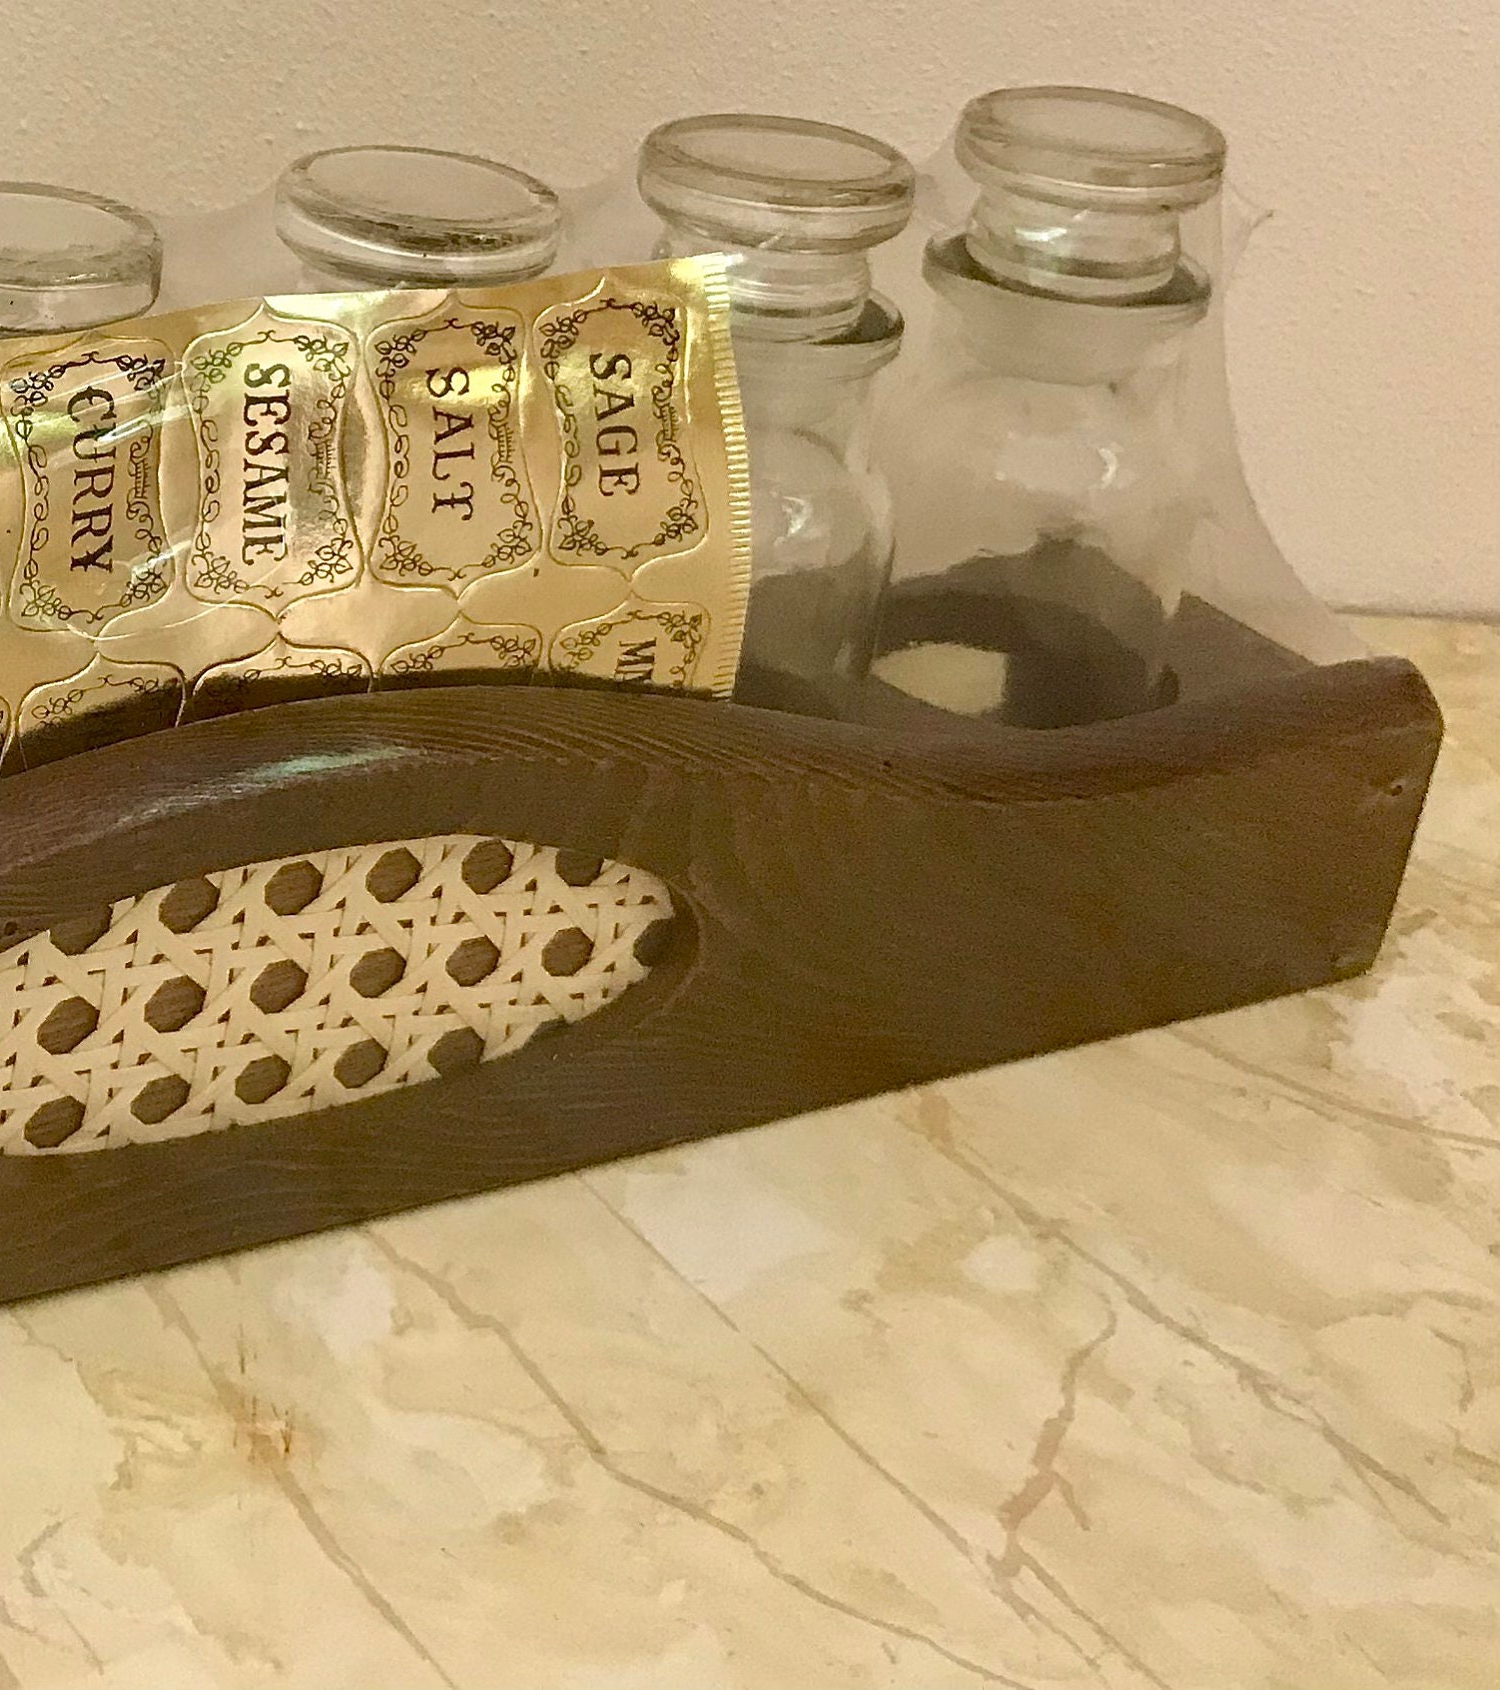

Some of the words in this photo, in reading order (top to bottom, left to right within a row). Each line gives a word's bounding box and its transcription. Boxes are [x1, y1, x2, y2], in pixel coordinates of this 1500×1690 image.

[67, 386, 117, 573] CURRY
[241, 362, 291, 566] SESAME
[425, 367, 474, 521] SALT
[588, 352, 641, 497] SAGE
